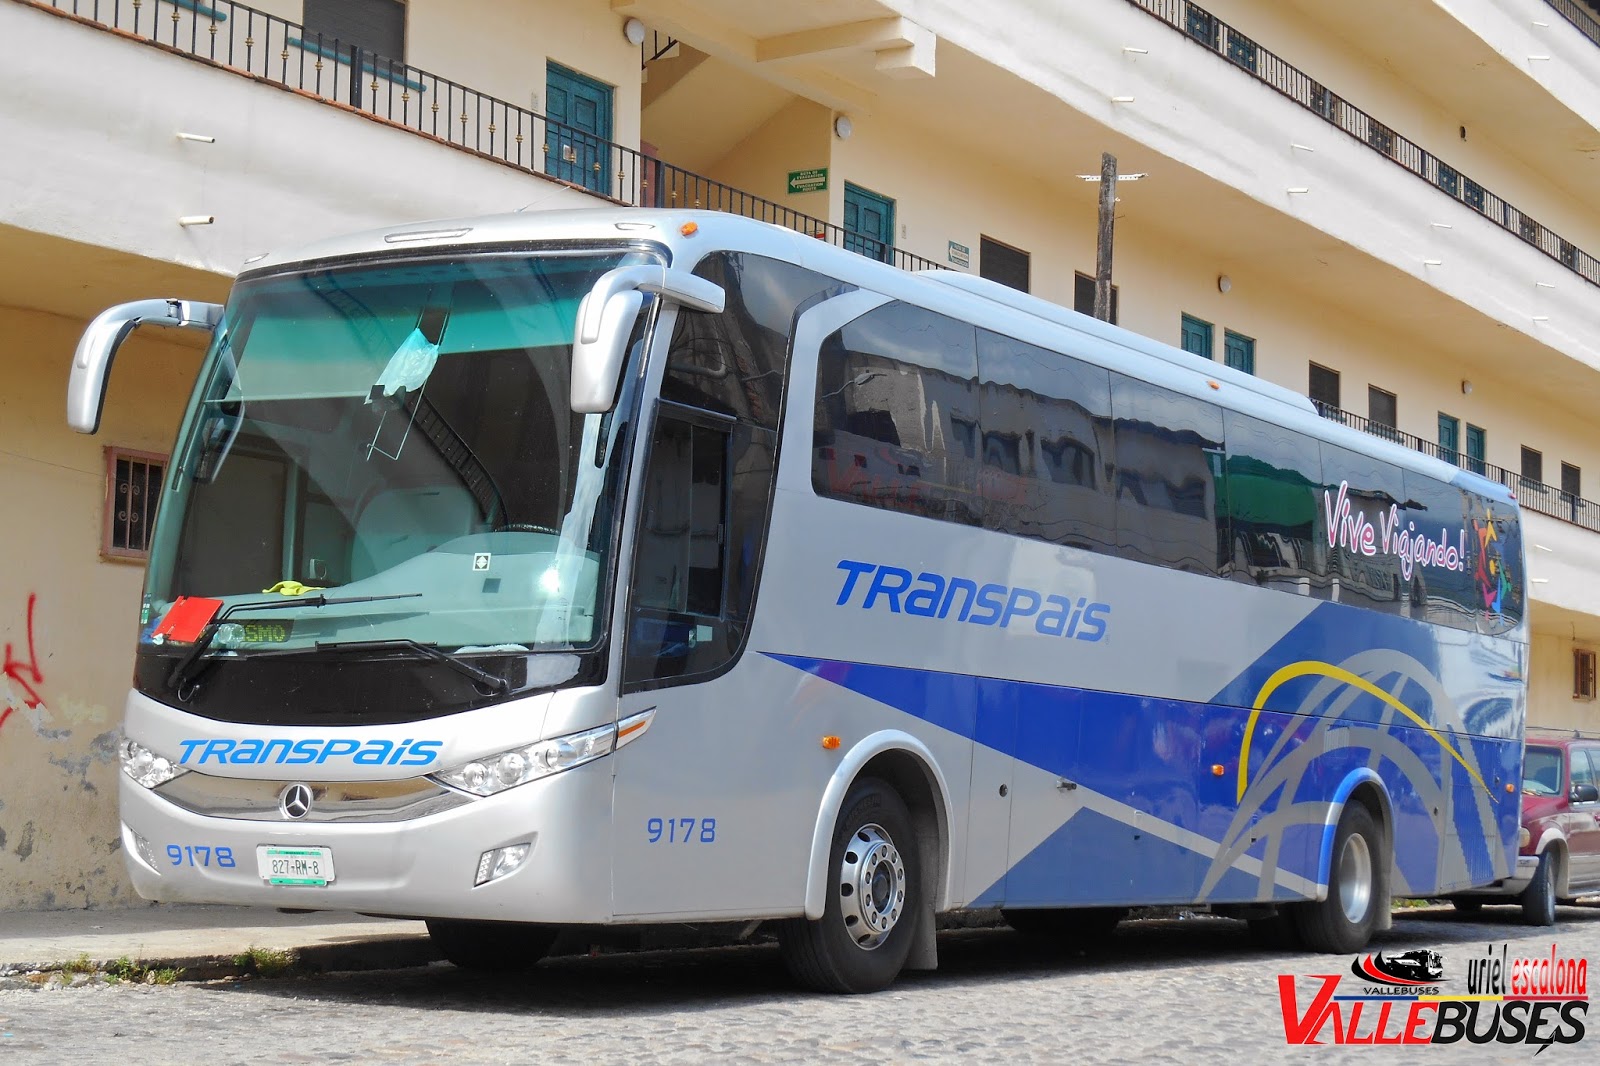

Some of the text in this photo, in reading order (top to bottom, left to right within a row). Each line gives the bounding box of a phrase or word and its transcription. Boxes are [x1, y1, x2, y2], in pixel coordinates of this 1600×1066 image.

[1325, 480, 1465, 581] Vive Viajando!
[243, 624, 286, 642] SMO
[647, 818, 716, 843] 9178
[166, 844, 236, 868] 9178
[272, 859, 320, 875] 827-RM-8
